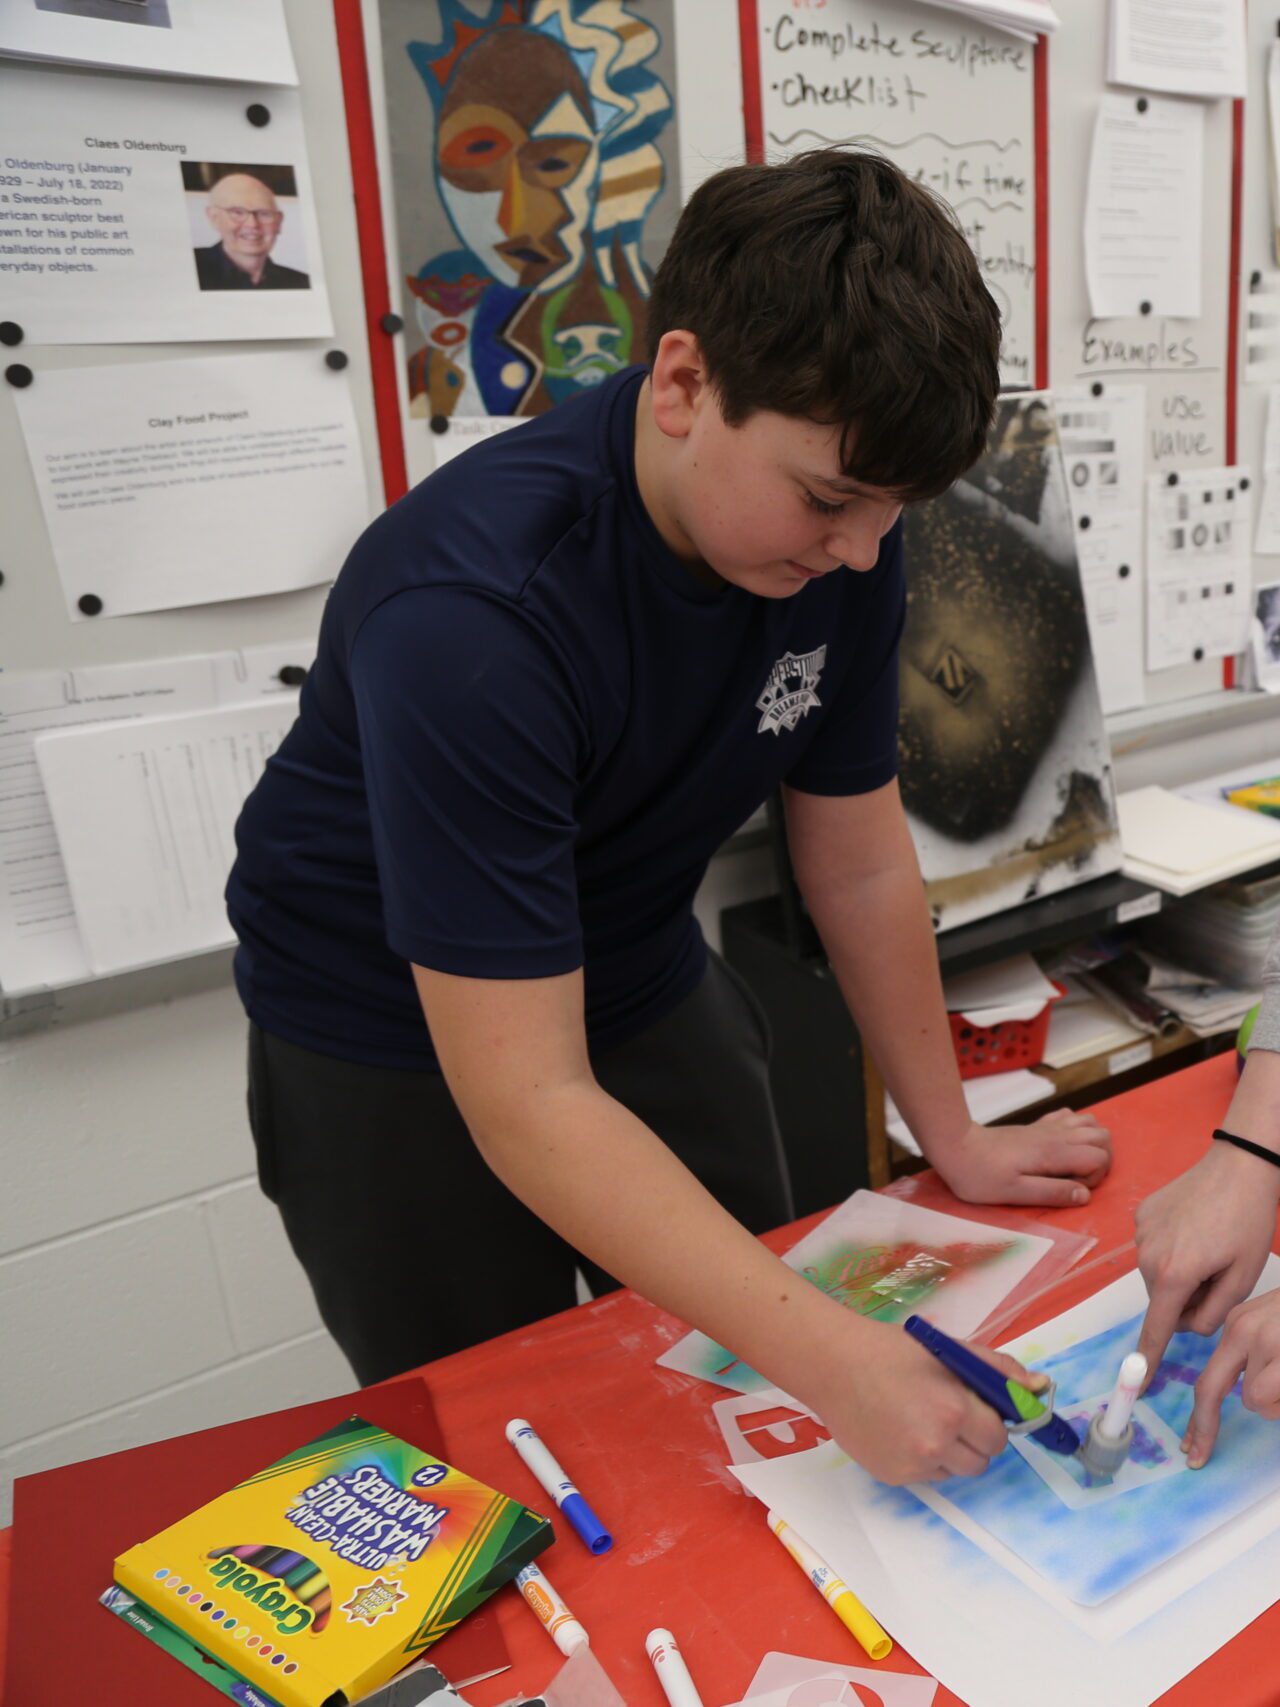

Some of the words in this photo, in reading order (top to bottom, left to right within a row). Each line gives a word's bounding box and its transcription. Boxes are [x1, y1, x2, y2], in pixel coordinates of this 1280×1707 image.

[774, 14, 904, 60] Complete
[85, 137, 120, 150] Claes
[123, 139, 187, 154] Oldenburg
[5, 158, 75, 175] Oldenburg
[78, 162, 133, 177] (January
[37, 178, 64, 191] July
[90, 180, 124, 192] 2022)
[13, 193, 102, 206] Swedish-born
[42, 212, 94, 224] sculptor
[97, 212, 125, 223] best
[25, 227, 43, 238] for
[47, 228, 67, 239] his
[71, 228, 109, 241] public
[112, 229, 129, 239] art
[0, 244, 61, 256] tallations
[65, 245, 78, 256] of
[81, 246, 134, 257] common
[48, 261, 98, 274] objects.
[1081, 318, 1199, 369] Examples
[148, 418, 173, 429] Clay
[415, 1466, 445, 1486] 12
[344, 1467, 448, 1531] MARKERS
[304, 1477, 430, 1560] WASHABLE
[287, 1506, 389, 1569] ULTRA-CLEAN
[208, 1556, 312, 1635] Crayola
